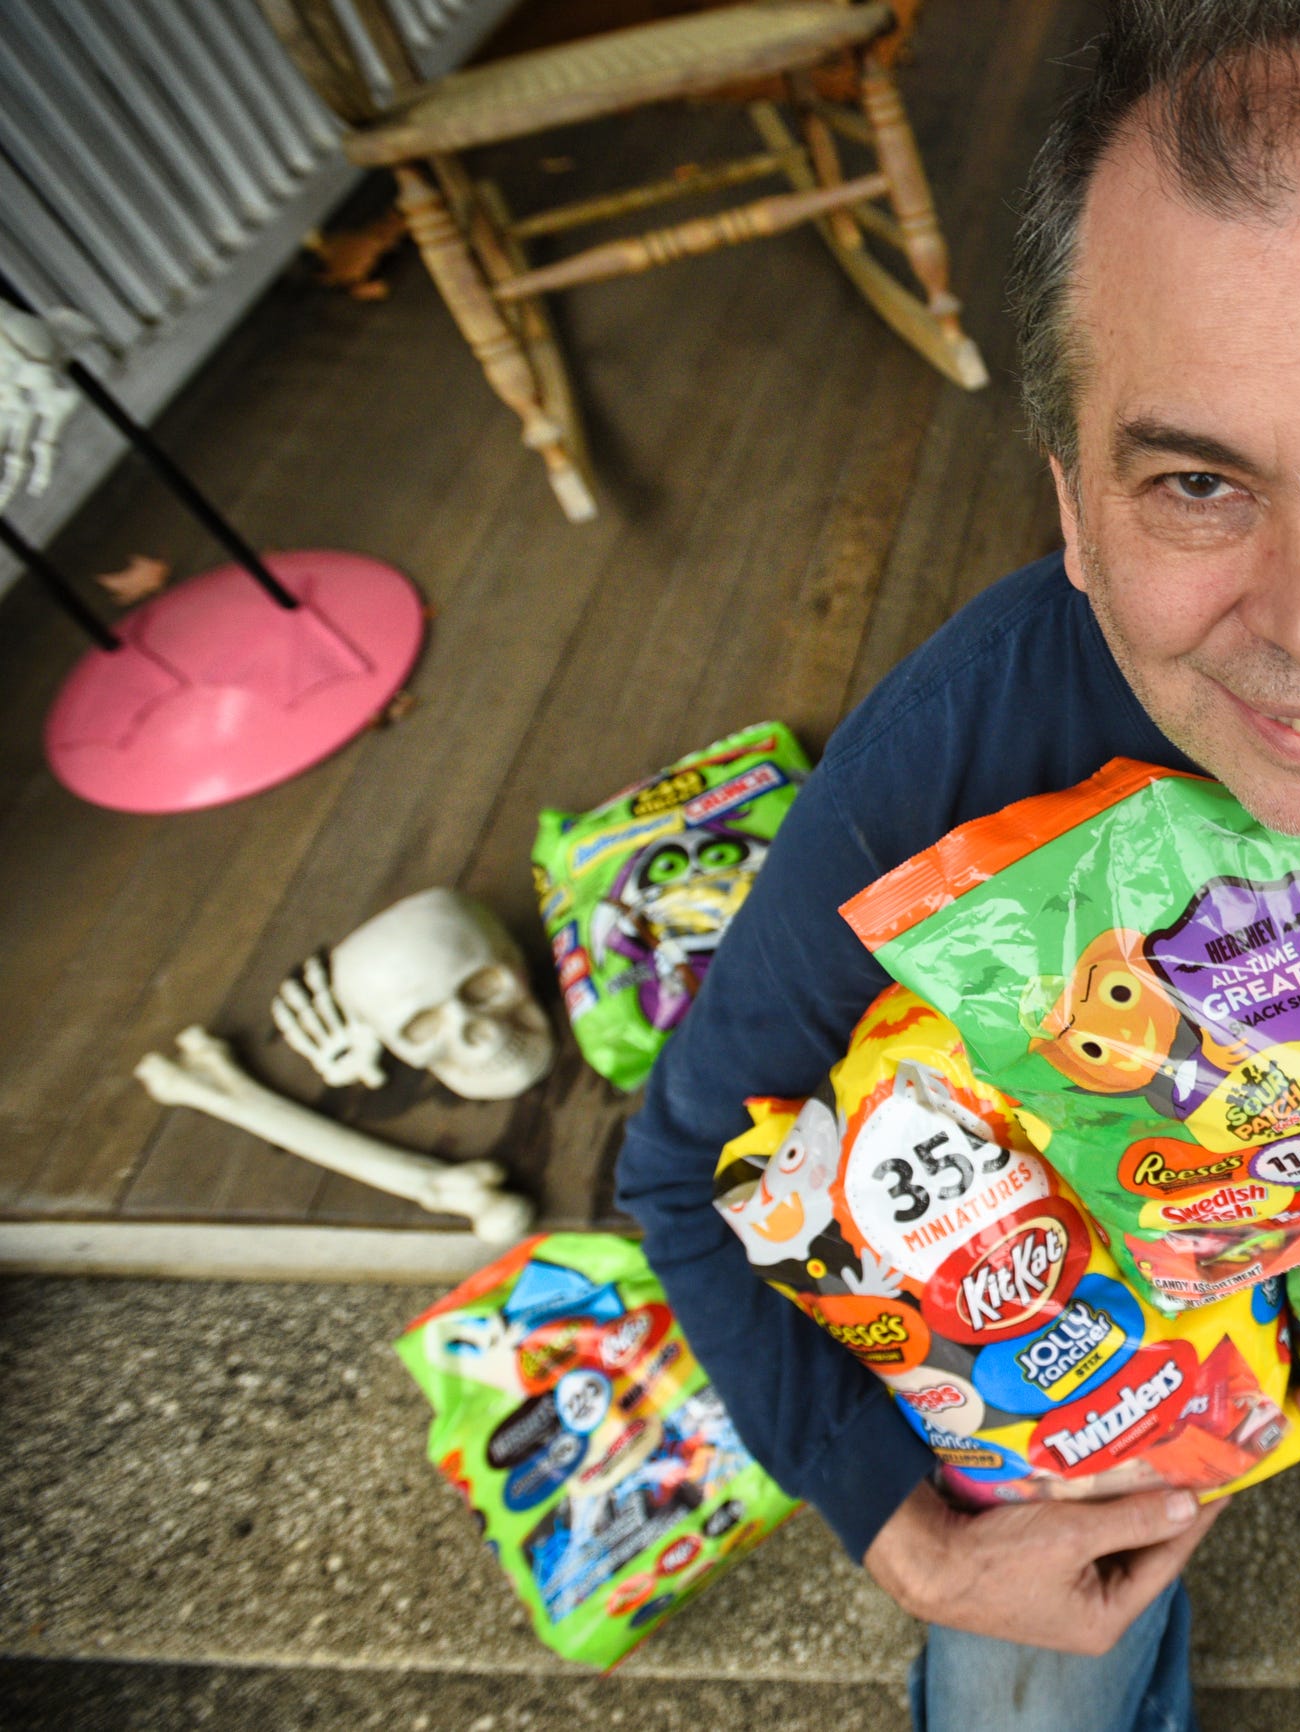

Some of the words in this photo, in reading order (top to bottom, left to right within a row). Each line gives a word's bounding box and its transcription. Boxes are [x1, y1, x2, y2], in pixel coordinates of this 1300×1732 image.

[1204, 917, 1277, 964] HERSHEY
[1211, 965, 1249, 989] ALL
[1246, 941, 1299, 976] TIME
[1229, 1001, 1288, 1038] SNACK
[1226, 1071, 1289, 1127] SOUR
[872, 1123, 1011, 1223] 355
[1133, 1151, 1244, 1185] Reese's
[902, 1161, 1032, 1252] MINIATURES
[1160, 1184, 1267, 1225] Swedish
[1154, 1279, 1189, 1291] CANDY
[1193, 1264, 1262, 1293] ASSORTMENT
[1019, 1302, 1094, 1379] JOLLY
[1038, 1313, 1112, 1388] rancher
[1075, 1352, 1103, 1377] STIX
[1043, 1360, 1184, 1467] Twizzlers
